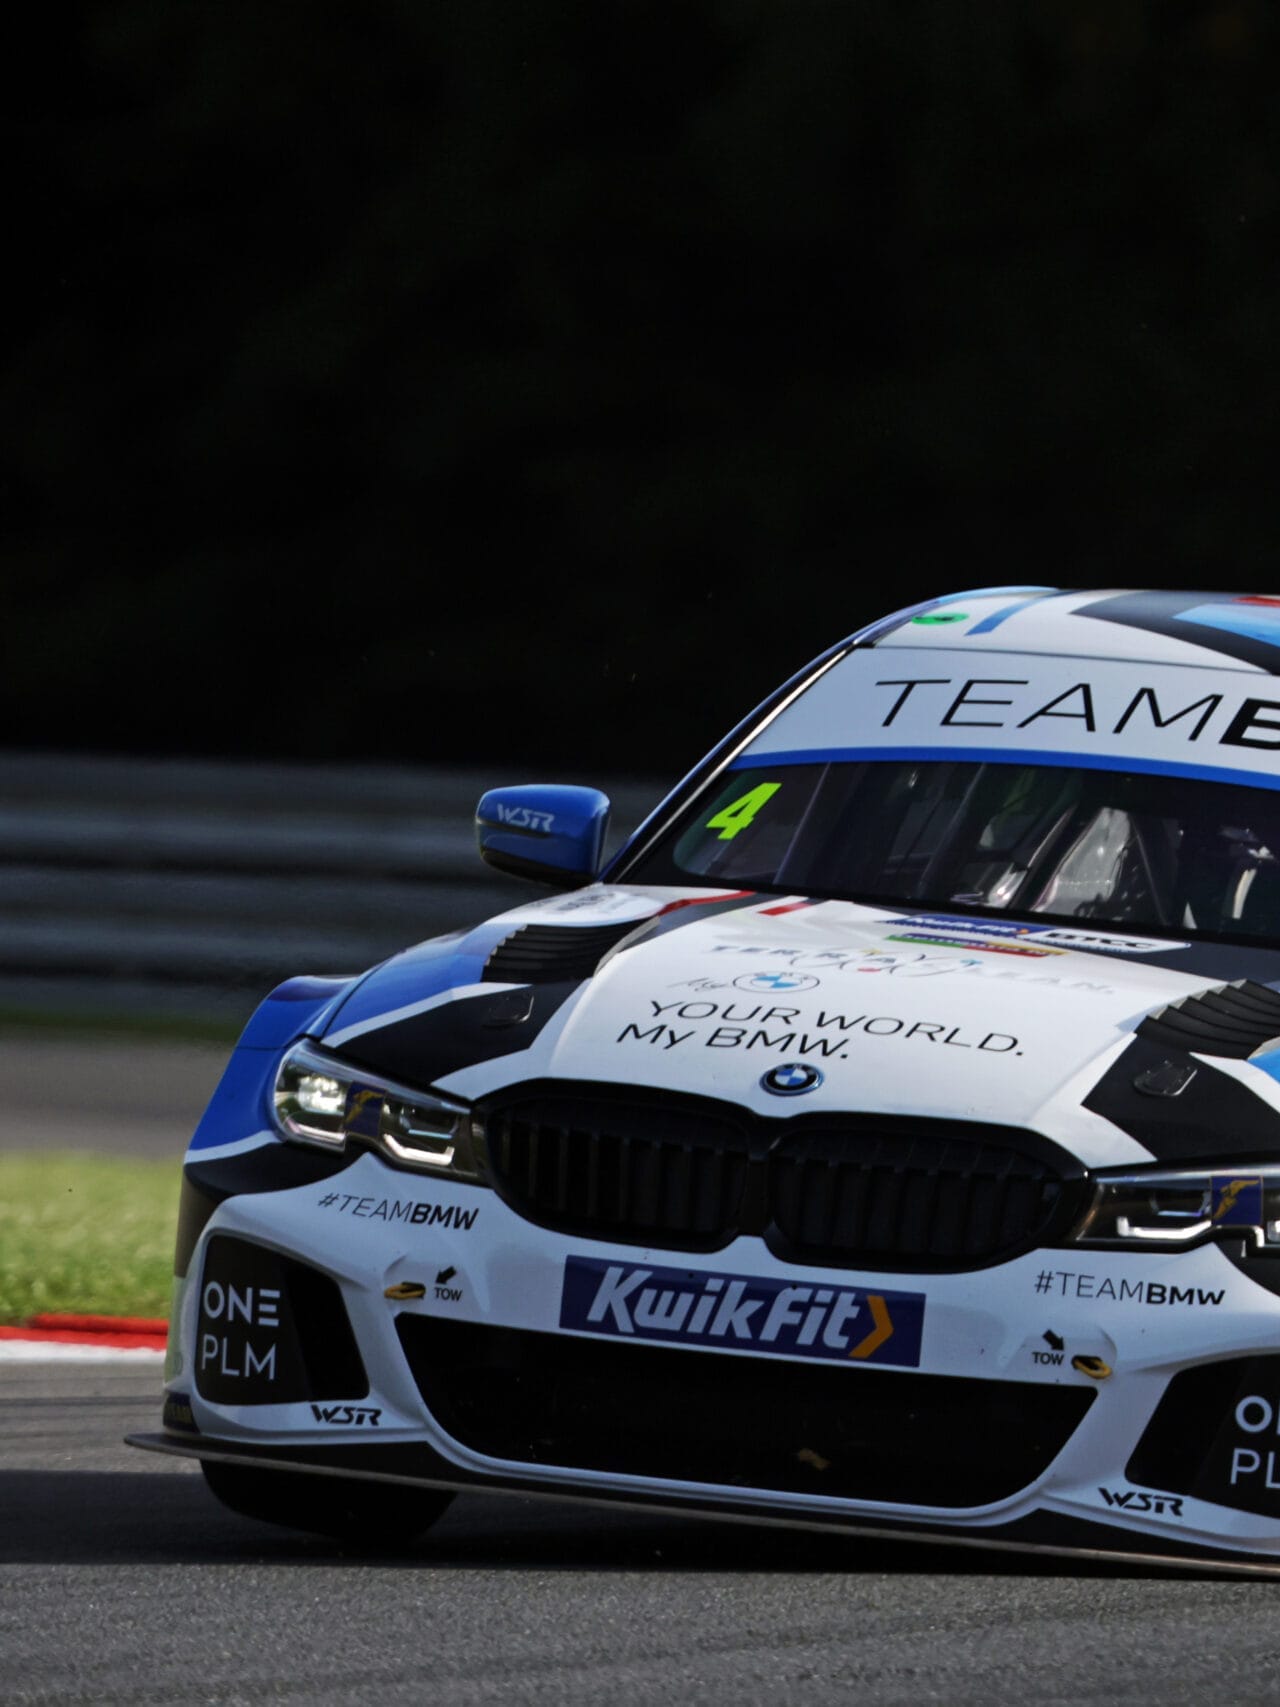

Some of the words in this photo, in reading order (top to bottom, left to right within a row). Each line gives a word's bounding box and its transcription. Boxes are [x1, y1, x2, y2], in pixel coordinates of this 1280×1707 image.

[496, 803, 555, 833] WSR
[705, 782, 782, 840] 4
[616, 1022, 696, 1051] My
[705, 1026, 850, 1059] BMW.
[650, 1000, 802, 1025] YOUR
[815, 1010, 1025, 1057] WORLD.
[317, 1191, 479, 1232] #TEAMBMW
[202, 1280, 281, 1328] ONE
[433, 1287, 464, 1302] TOW
[1034, 1269, 1226, 1306] #TEAMBMW
[201, 1333, 277, 1381] PLM
[1032, 1351, 1065, 1366] TOW
[310, 1404, 383, 1427] WSR
[1097, 1486, 1185, 1518] WSR
